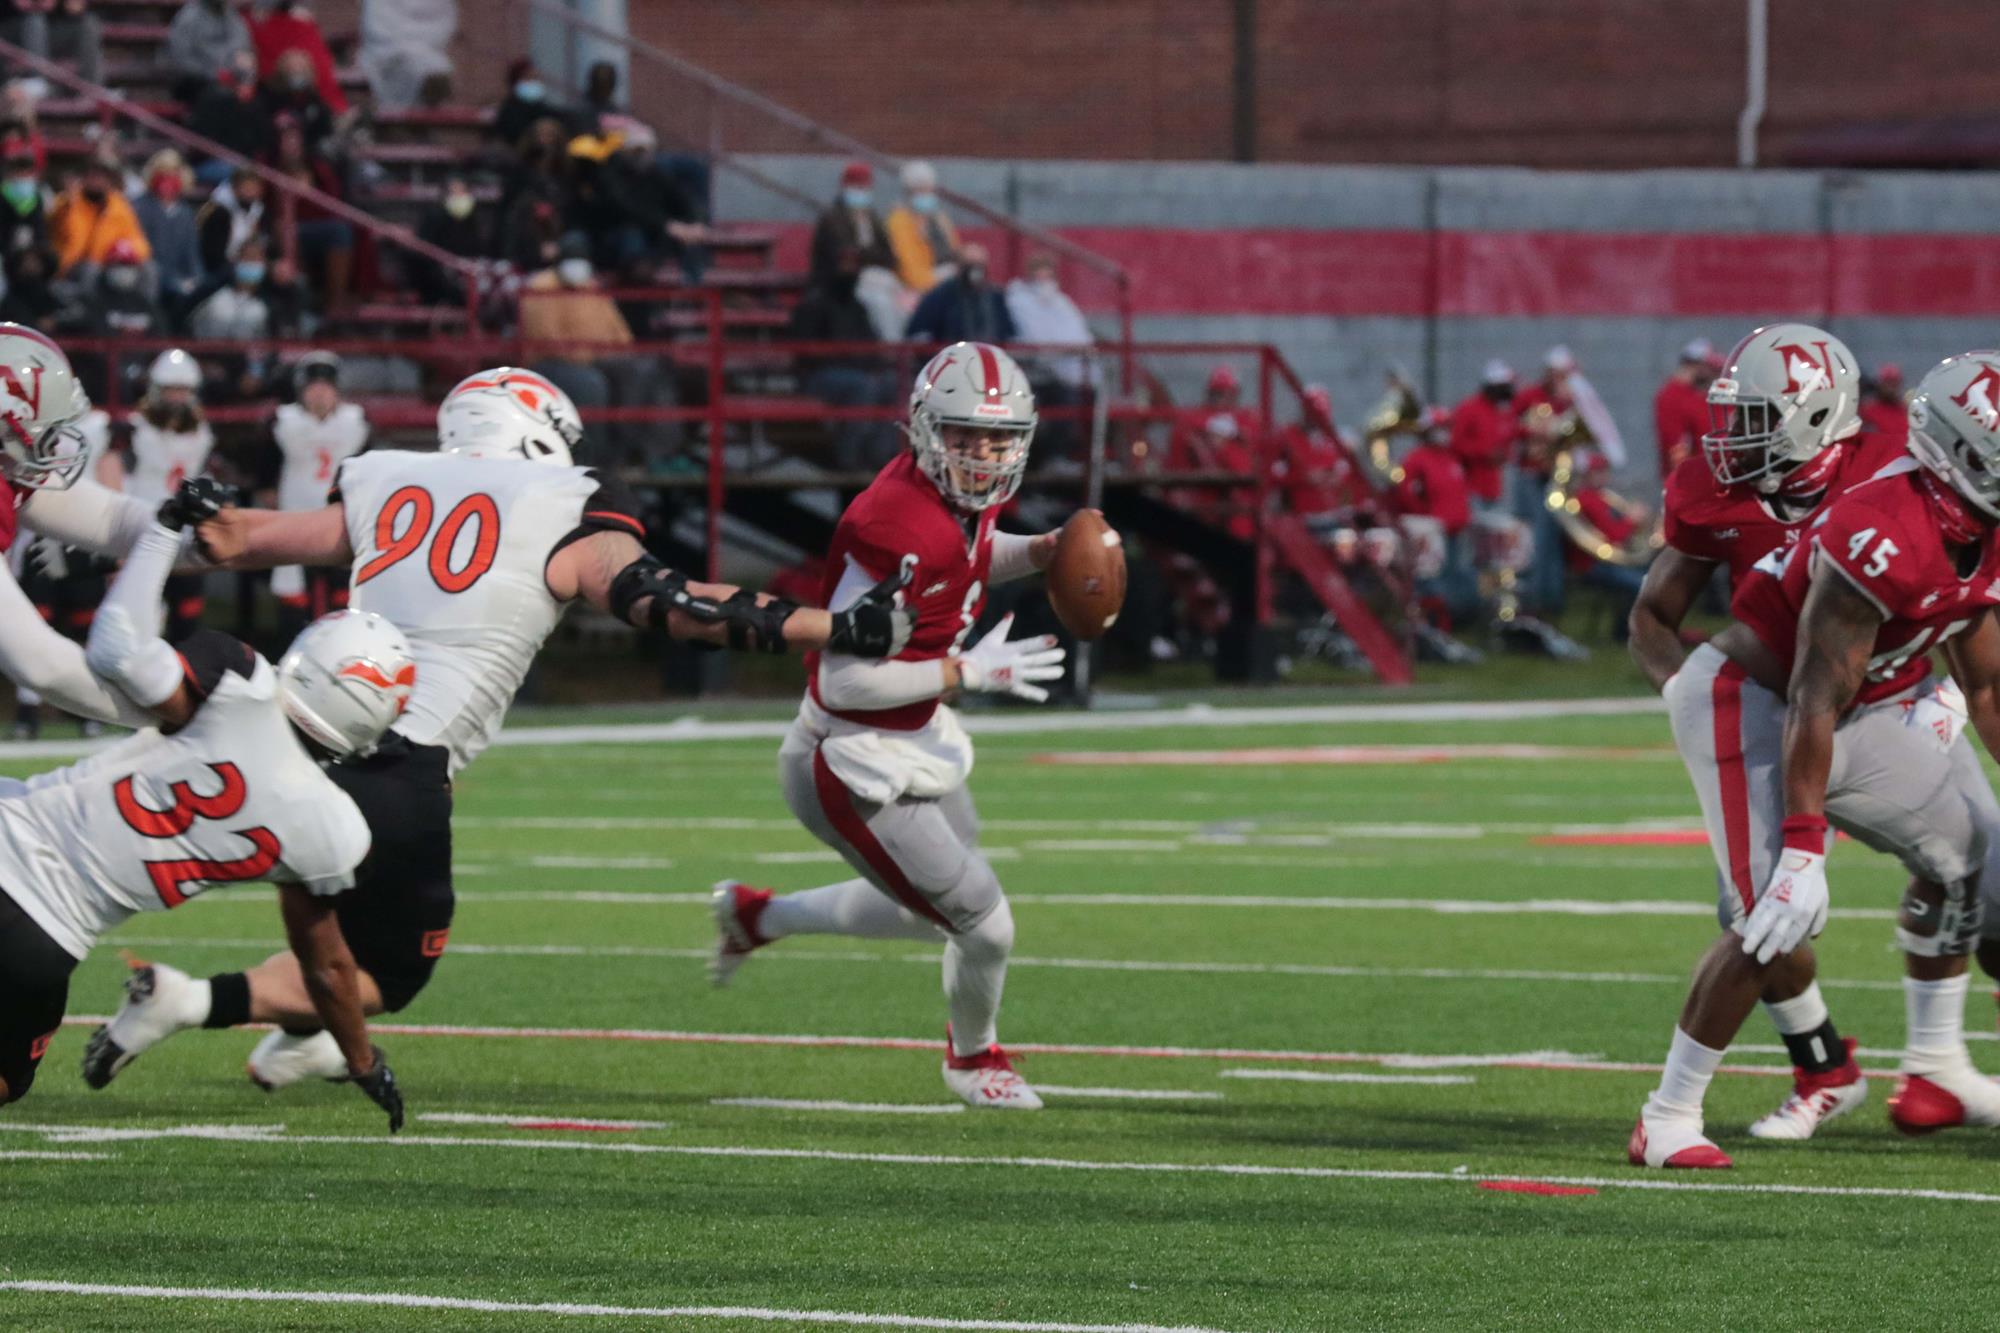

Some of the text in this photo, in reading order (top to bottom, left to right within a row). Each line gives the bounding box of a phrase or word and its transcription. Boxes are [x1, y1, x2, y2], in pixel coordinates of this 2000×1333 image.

[1774, 341, 1836, 394] N
[354, 485, 501, 594] 90
[1848, 527, 1900, 578] 45
[112, 761, 282, 909] 32
